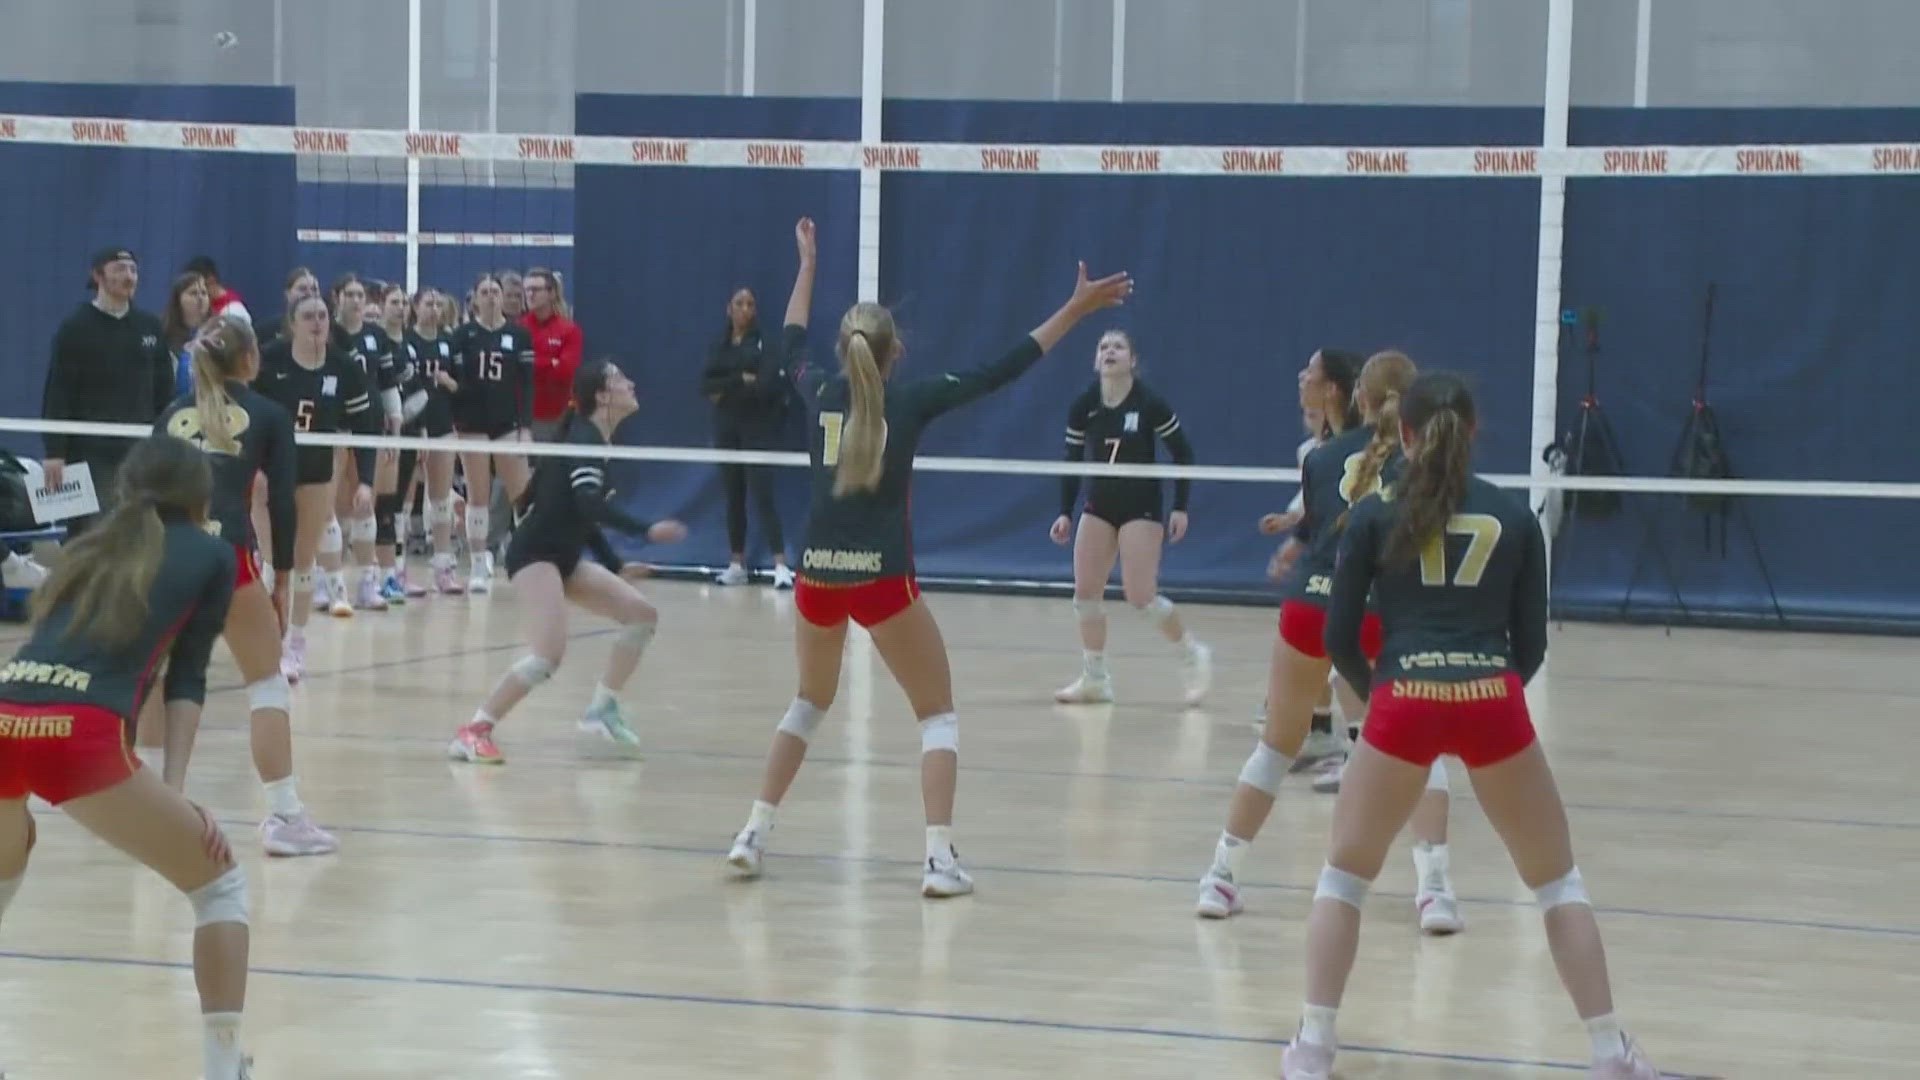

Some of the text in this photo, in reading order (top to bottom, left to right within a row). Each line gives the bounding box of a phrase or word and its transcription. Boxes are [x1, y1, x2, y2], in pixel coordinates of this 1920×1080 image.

[72, 121, 127, 142] SPOKANE
[182, 127, 236, 148] SPOKANE
[293, 130, 349, 152] SPOKANE
[405, 133, 461, 156] SPOKANE
[518, 137, 575, 159] SPOKANE
[632, 141, 688, 163] SPOKANE
[747, 144, 804, 166] SPOKANE
[863, 147, 921, 168] SPOKANE
[981, 149, 1040, 171] SPOKANE
[1101, 150, 1160, 171] SPOKANE
[1222, 151, 1284, 172] SPOKANE
[1347, 150, 1408, 173] SPOKANE
[1474, 150, 1537, 172] SPOKANE
[1603, 150, 1668, 172] SPOKANE
[1736, 150, 1802, 172] SPOKANE
[478, 350, 503, 381] 15
[294, 399, 315, 433] 5
[1104, 438, 1121, 466] 7
[1418, 513, 1502, 587] 17
